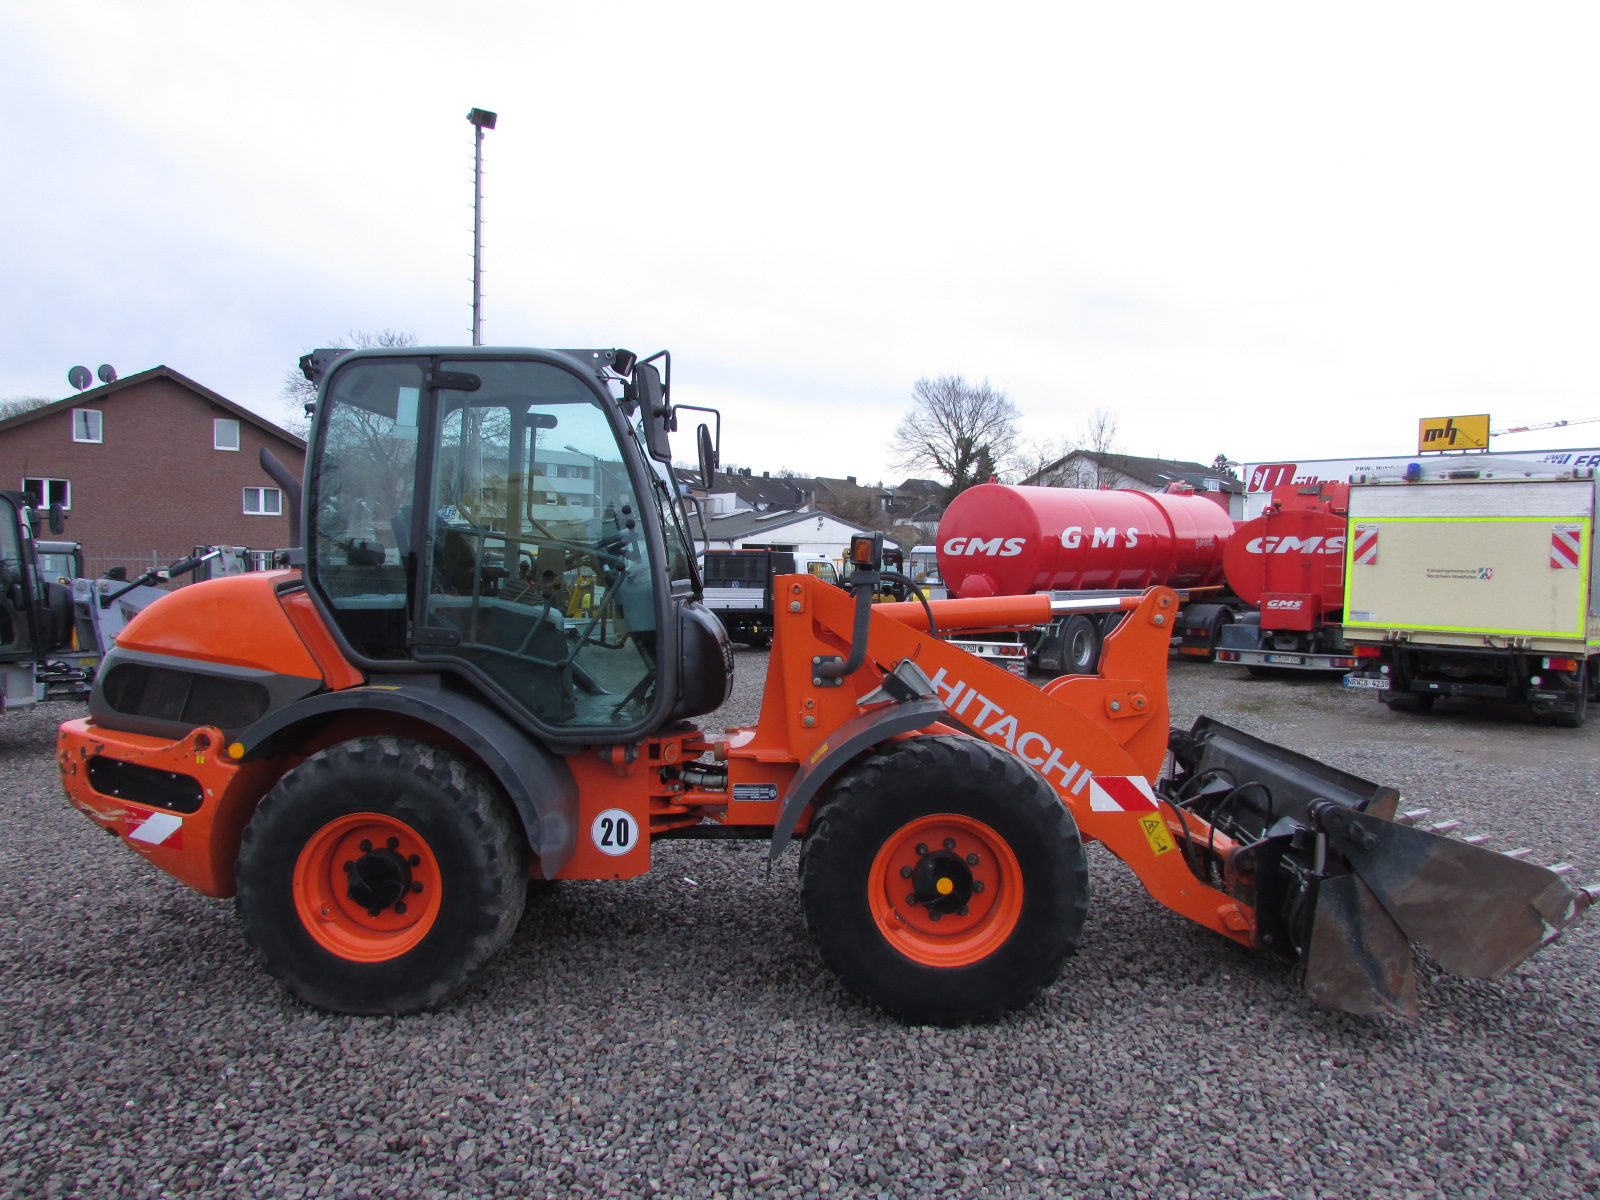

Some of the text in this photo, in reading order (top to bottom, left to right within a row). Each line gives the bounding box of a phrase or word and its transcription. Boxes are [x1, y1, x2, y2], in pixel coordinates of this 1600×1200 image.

[943, 537, 1026, 557] GMS
[1245, 536, 1346, 554] GMS
[1267, 599, 1303, 607] GMS
[930, 667, 1093, 796] HITACHI
[601, 818, 629, 847] 20
